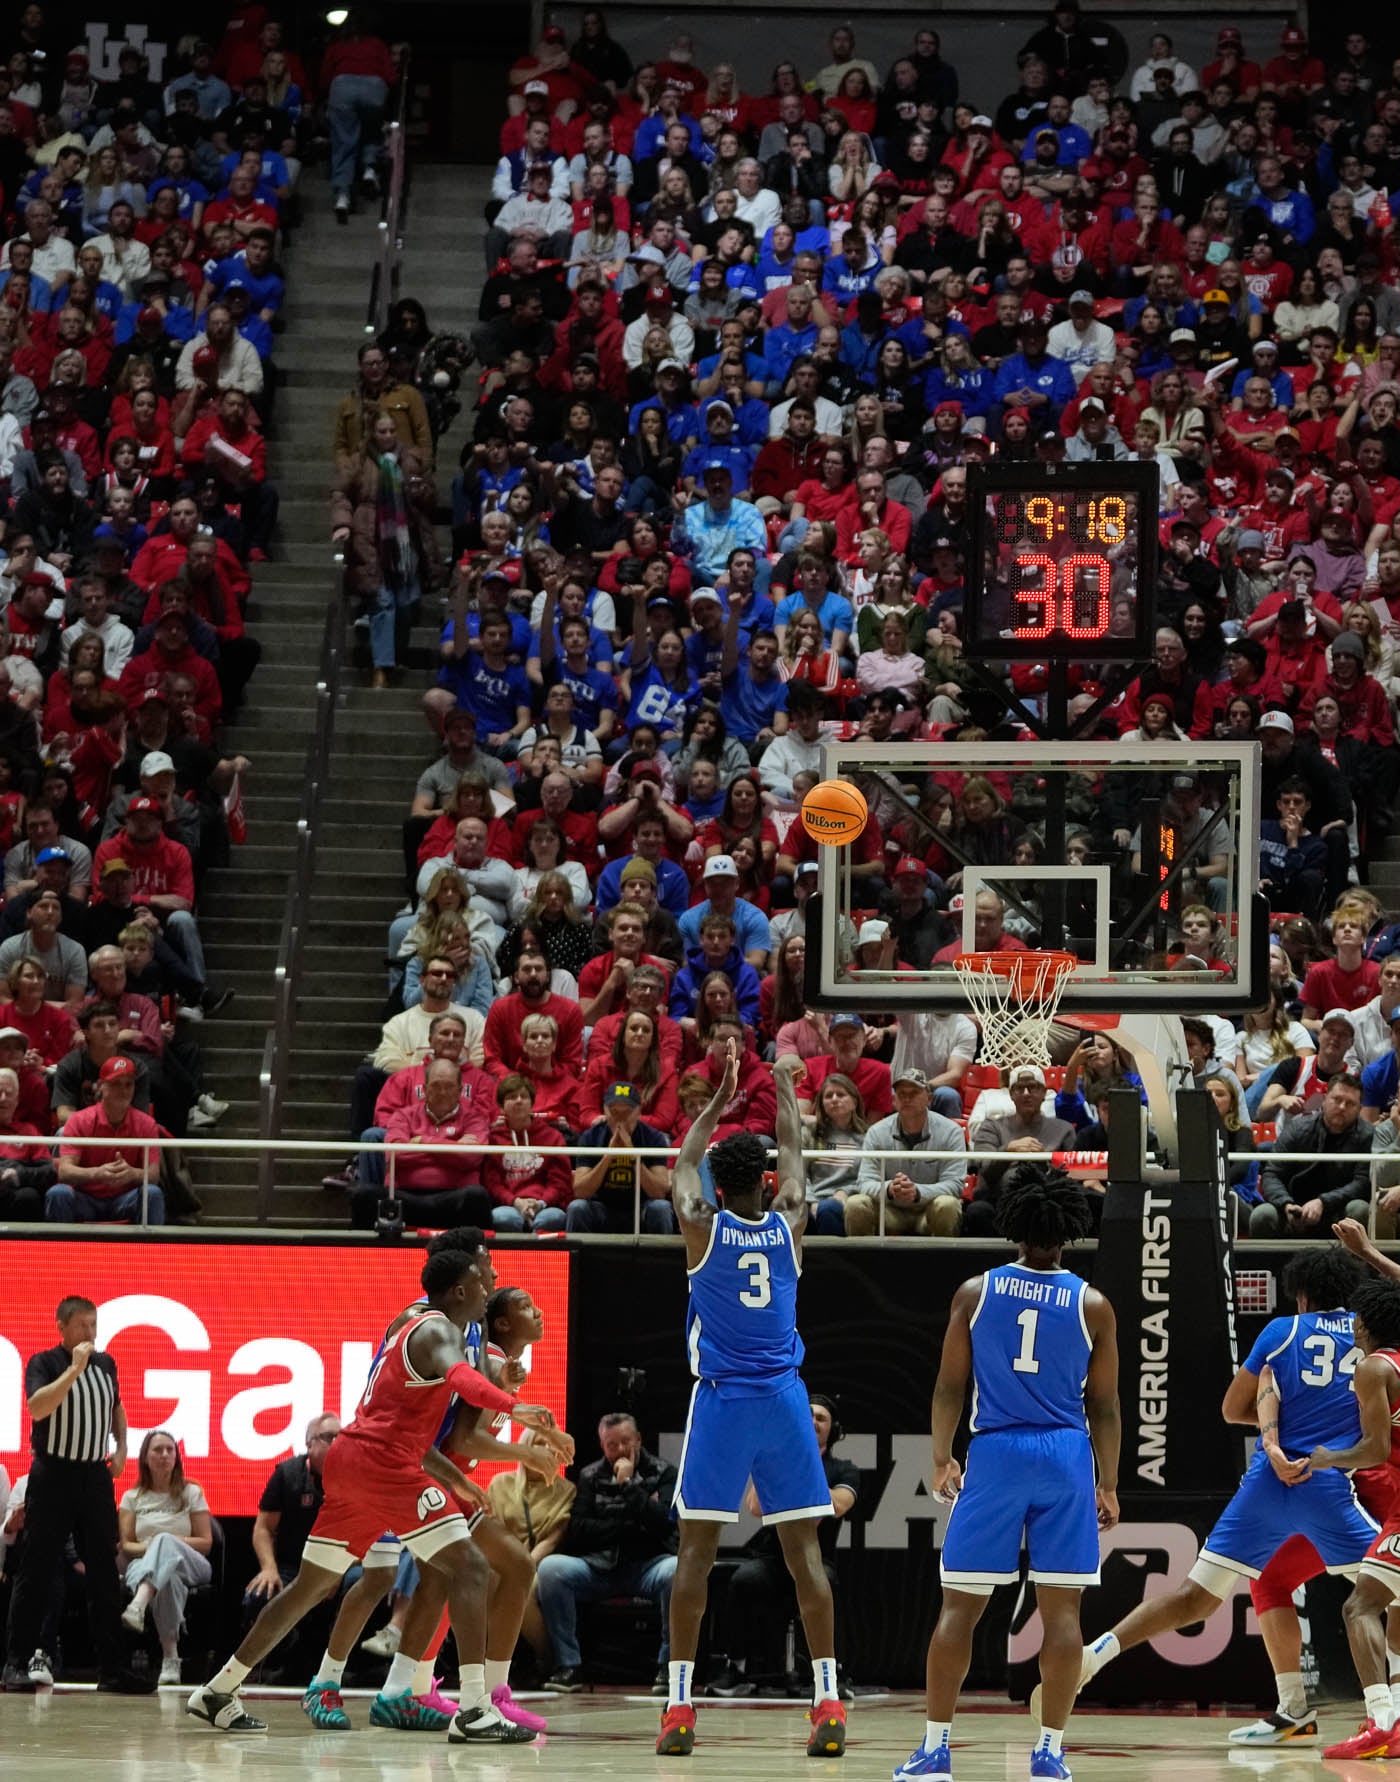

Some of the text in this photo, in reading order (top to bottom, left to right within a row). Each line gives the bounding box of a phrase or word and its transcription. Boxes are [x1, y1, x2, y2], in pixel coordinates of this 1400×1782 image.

[1027, 496, 1126, 544] 9:18
[1014, 554, 1110, 638] 30
[805, 812, 846, 829] Wilson
[615, 1085, 631, 1097] M
[722, 1227, 785, 1248] DYBANTSA
[738, 1252, 772, 1309] 3
[994, 1276, 1072, 1308] WRIGHT III
[1013, 1308, 1040, 1373] 1
[1137, 1190, 1173, 1486] AMERICA FIRST
[1223, 1250, 1239, 1377] ERICA
[1301, 1334, 1366, 1392] 34
